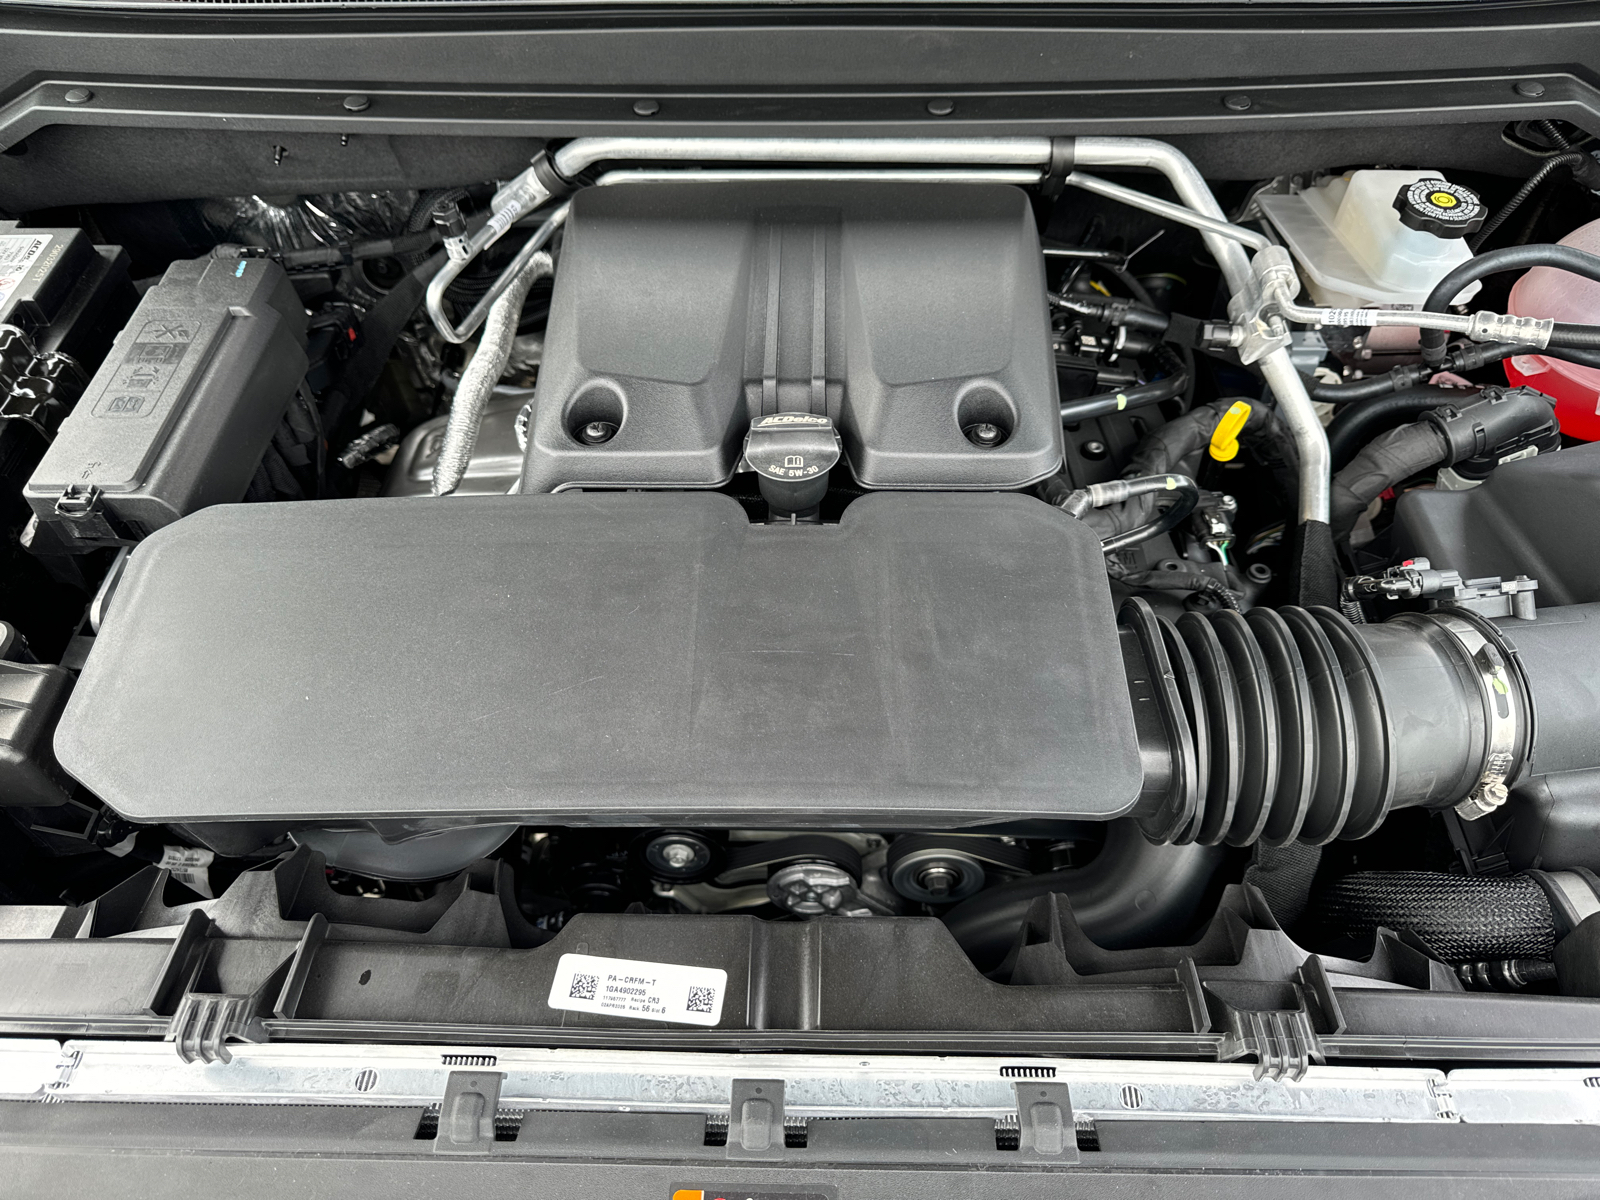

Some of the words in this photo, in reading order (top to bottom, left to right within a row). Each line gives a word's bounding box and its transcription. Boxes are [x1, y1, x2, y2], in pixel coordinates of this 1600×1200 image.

[759, 416, 828, 426] ACDelco
[768, 464, 785, 475] SAE
[788, 465, 819, 477] 5W-30
[606, 985, 647, 996] 1GA4902295
[647, 996, 660, 1004] CR3
[642, 1004, 651, 1012] 56
[661, 1006, 666, 1014] 6
